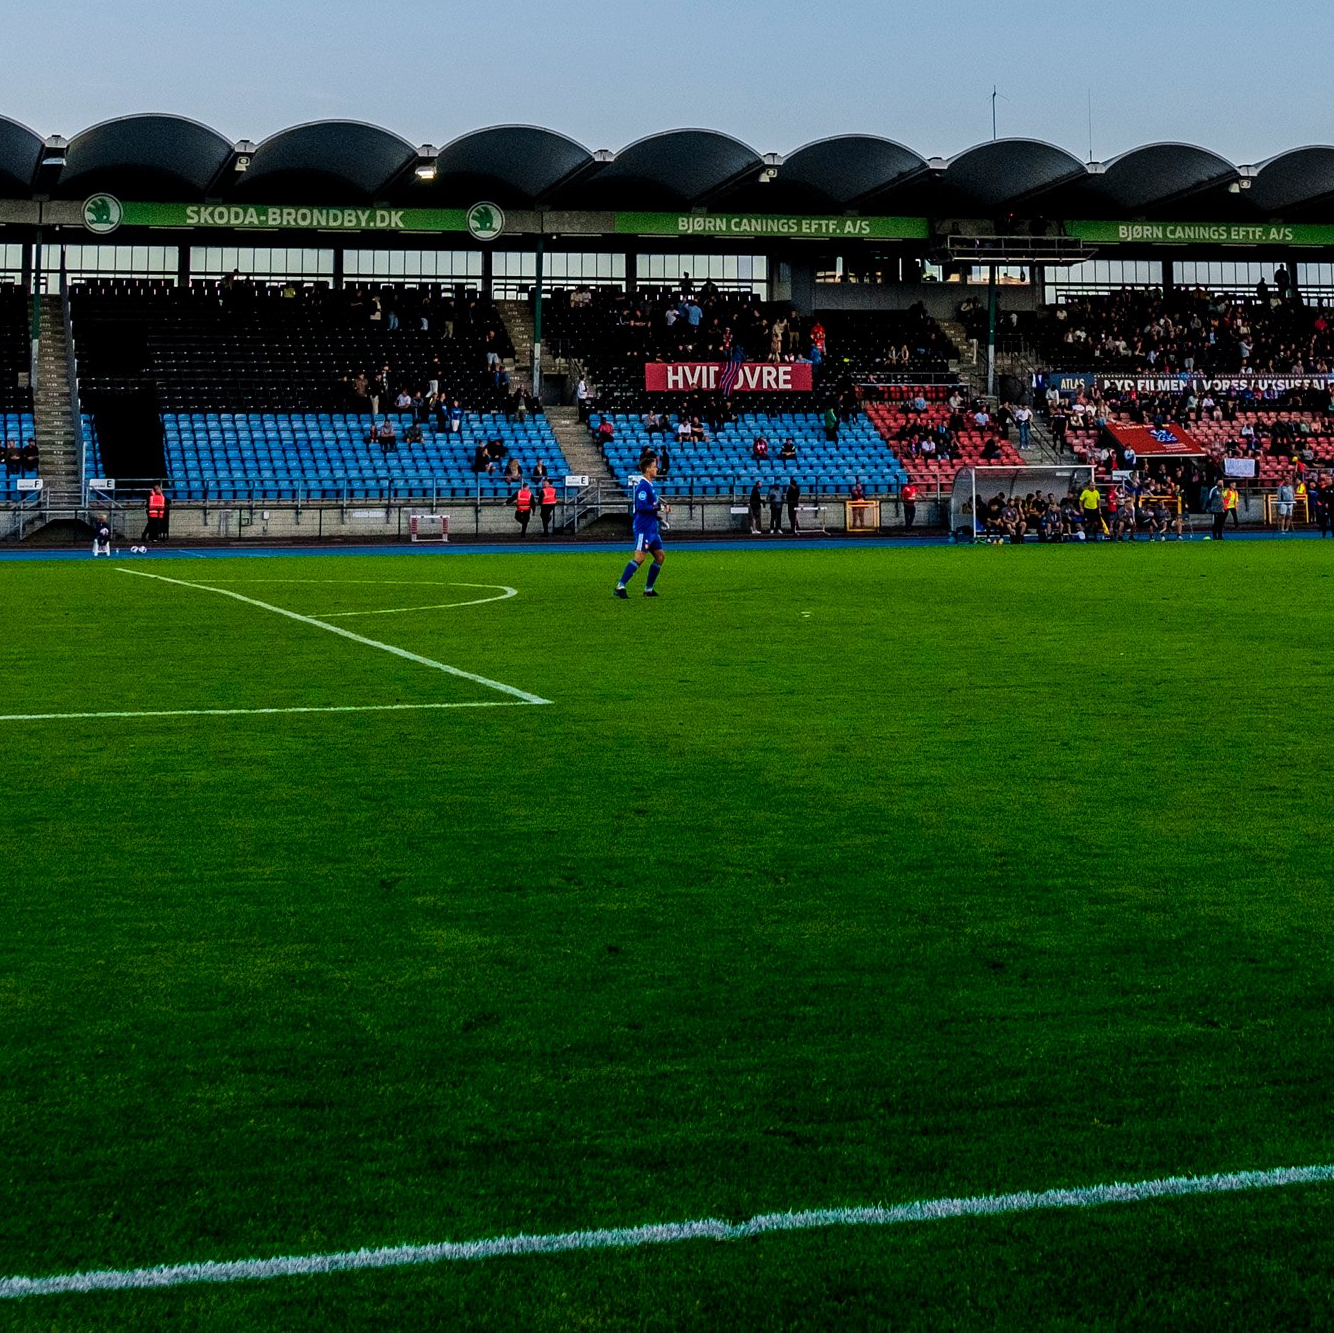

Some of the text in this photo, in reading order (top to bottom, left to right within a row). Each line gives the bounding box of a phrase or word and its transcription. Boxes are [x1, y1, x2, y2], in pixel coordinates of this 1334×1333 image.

[185, 206, 405, 228] SKODA-BRONDBY.DK
[678, 217, 871, 234] BJØRN CANINGS EFTF. A/S
[1118, 225, 1293, 241] BJØRN CANINGS EFTF. A/S
[34, 480, 40, 488] F
[106, 479, 113, 488] E
[580, 476, 586, 485] E
